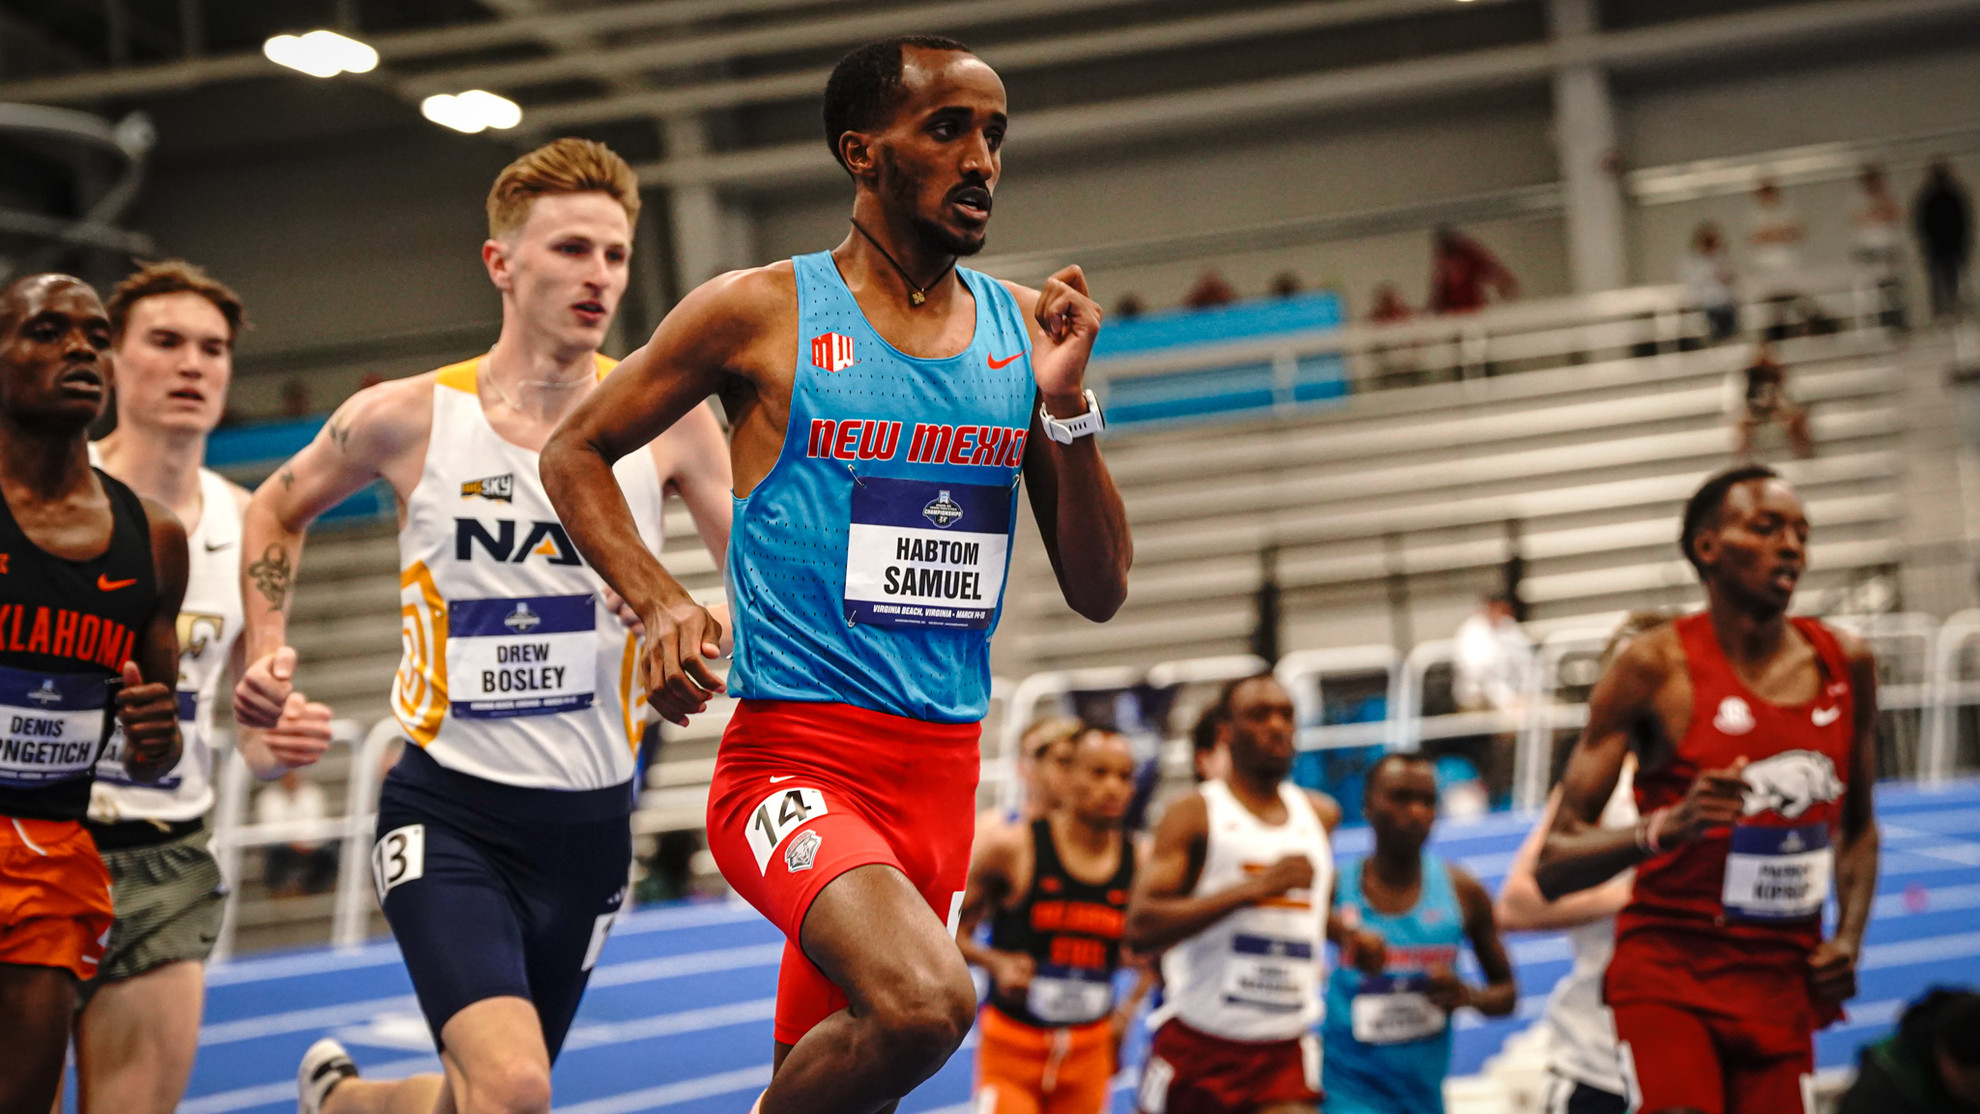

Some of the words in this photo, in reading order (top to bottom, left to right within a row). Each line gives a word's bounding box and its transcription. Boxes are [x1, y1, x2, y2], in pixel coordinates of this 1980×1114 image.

[807, 418, 903, 461] NEW
[896, 537, 979, 565] HABTOM
[883, 566, 981, 600] SAMUEL
[873, 604, 900, 615] VIRGINIA
[925, 609, 952, 618] VIRGINIA
[956, 610, 974, 619] MARCH
[497, 643, 550, 663] DREW
[482, 665, 566, 692] BOSLEY
[10, 716, 65, 737] DENIS
[0, 738, 92, 764] NGETICH
[754, 790, 812, 848] 14
